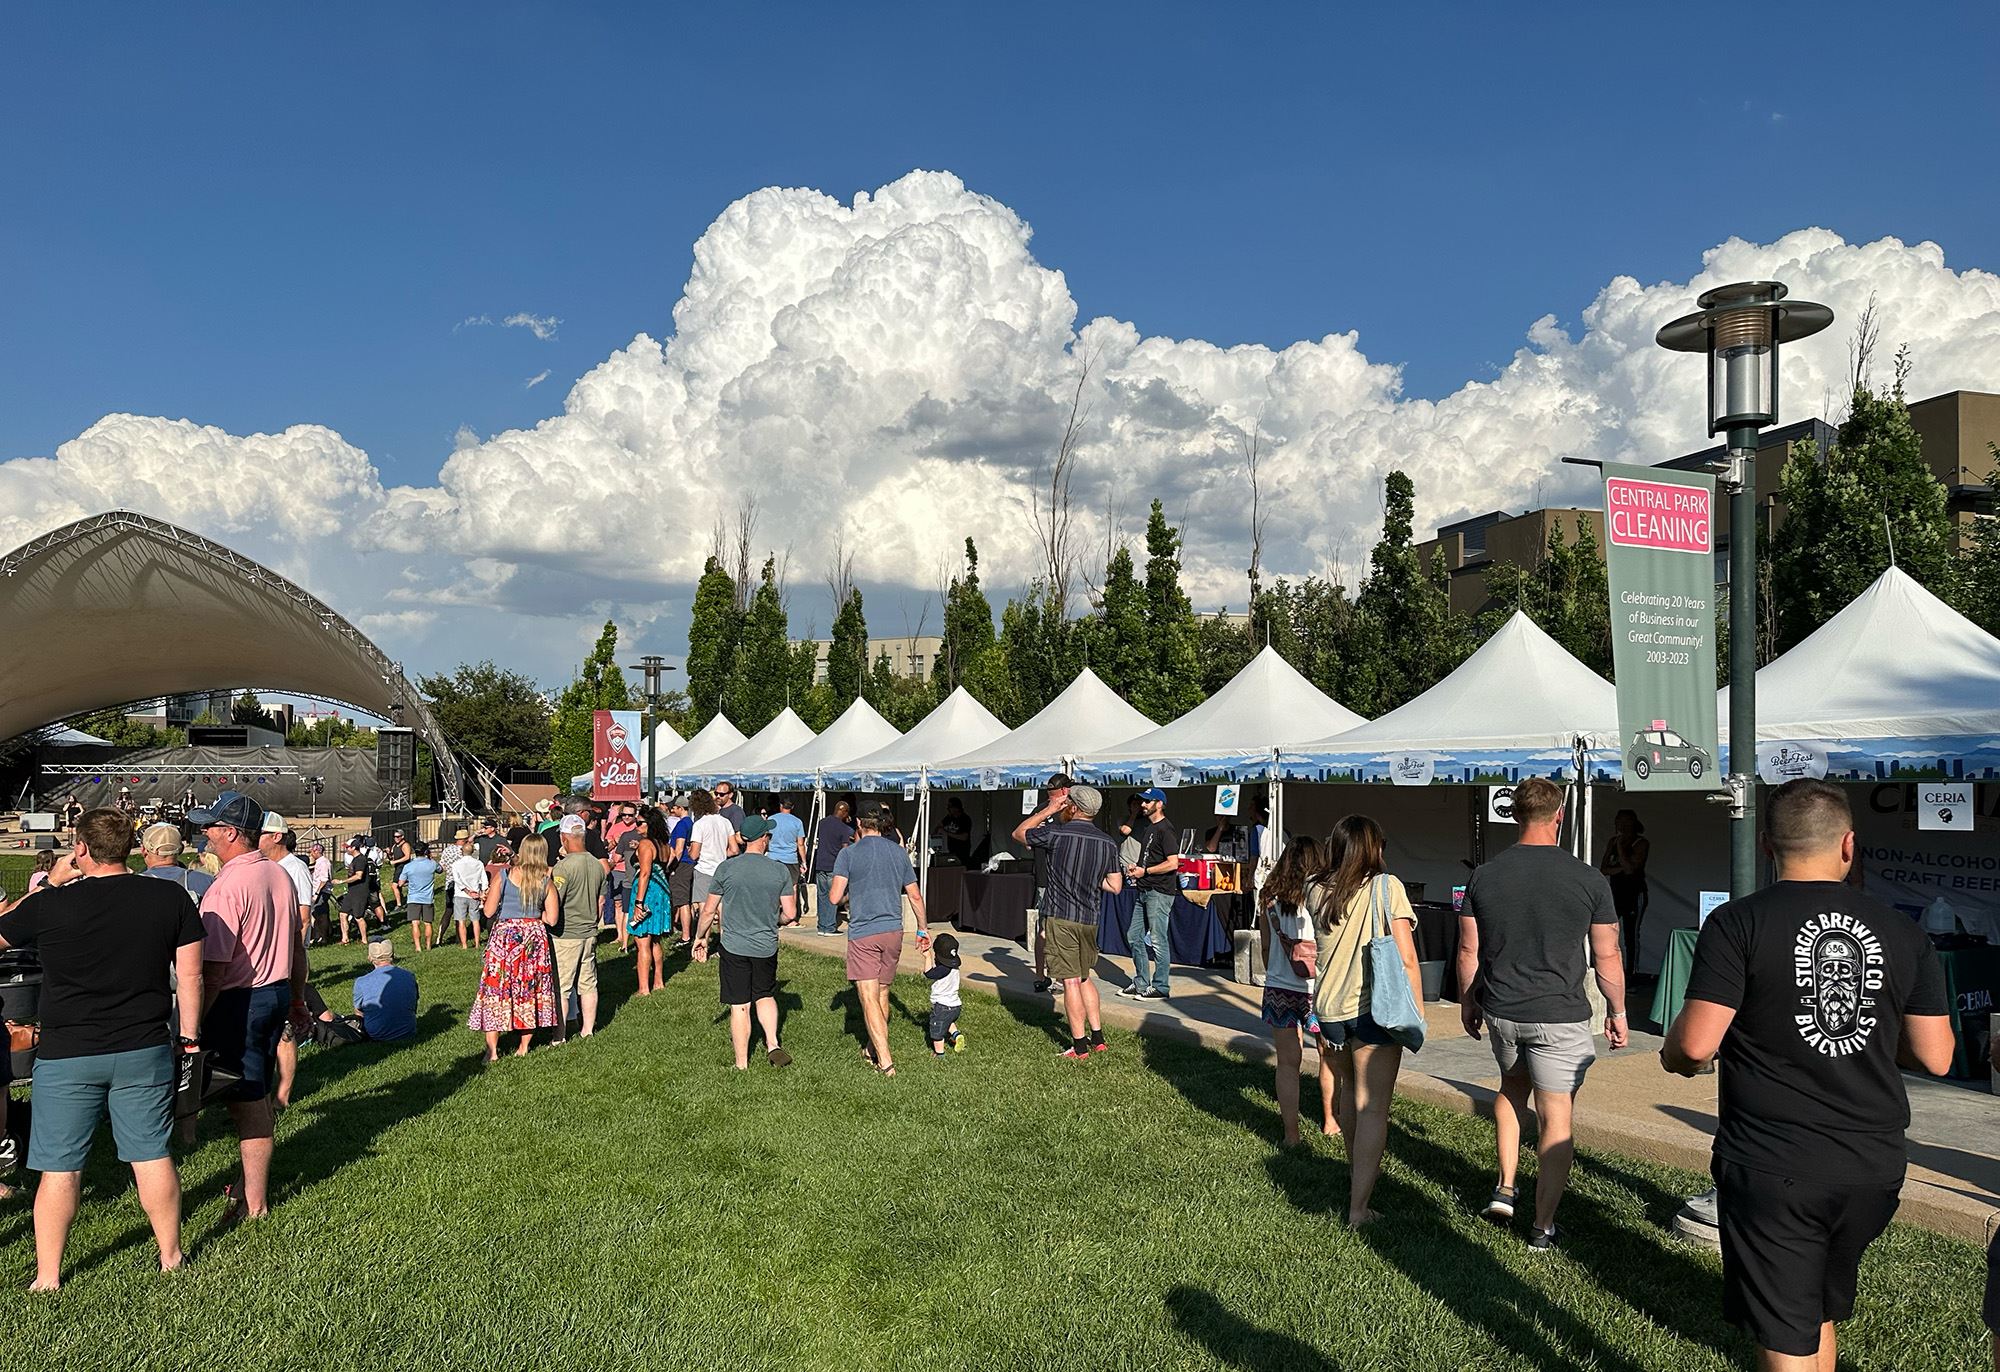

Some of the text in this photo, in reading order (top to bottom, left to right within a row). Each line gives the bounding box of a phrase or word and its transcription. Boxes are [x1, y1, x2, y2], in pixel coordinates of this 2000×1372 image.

[1610, 486, 1707, 514] CENTRAL PARK
[1612, 511, 1708, 545] CLEANING
[1620, 591, 1705, 610] Celebrating 20 Years
[1629, 611, 1699, 627] of Business in our
[1628, 630, 1703, 649] Great Community!
[1646, 650, 1689, 665] 2003-2023
[600, 763, 638, 788] Local
[1924, 792, 1967, 804] CERIA
[1861, 846, 2000, 870] NON-ALCOHO
[1881, 868, 1946, 887] CRAFT
[1794, 912, 1884, 990] STURGIS BREWING CO
[1956, 989, 1993, 1011] CERIA
[1794, 1014, 1877, 1058] BLACK HILLS
